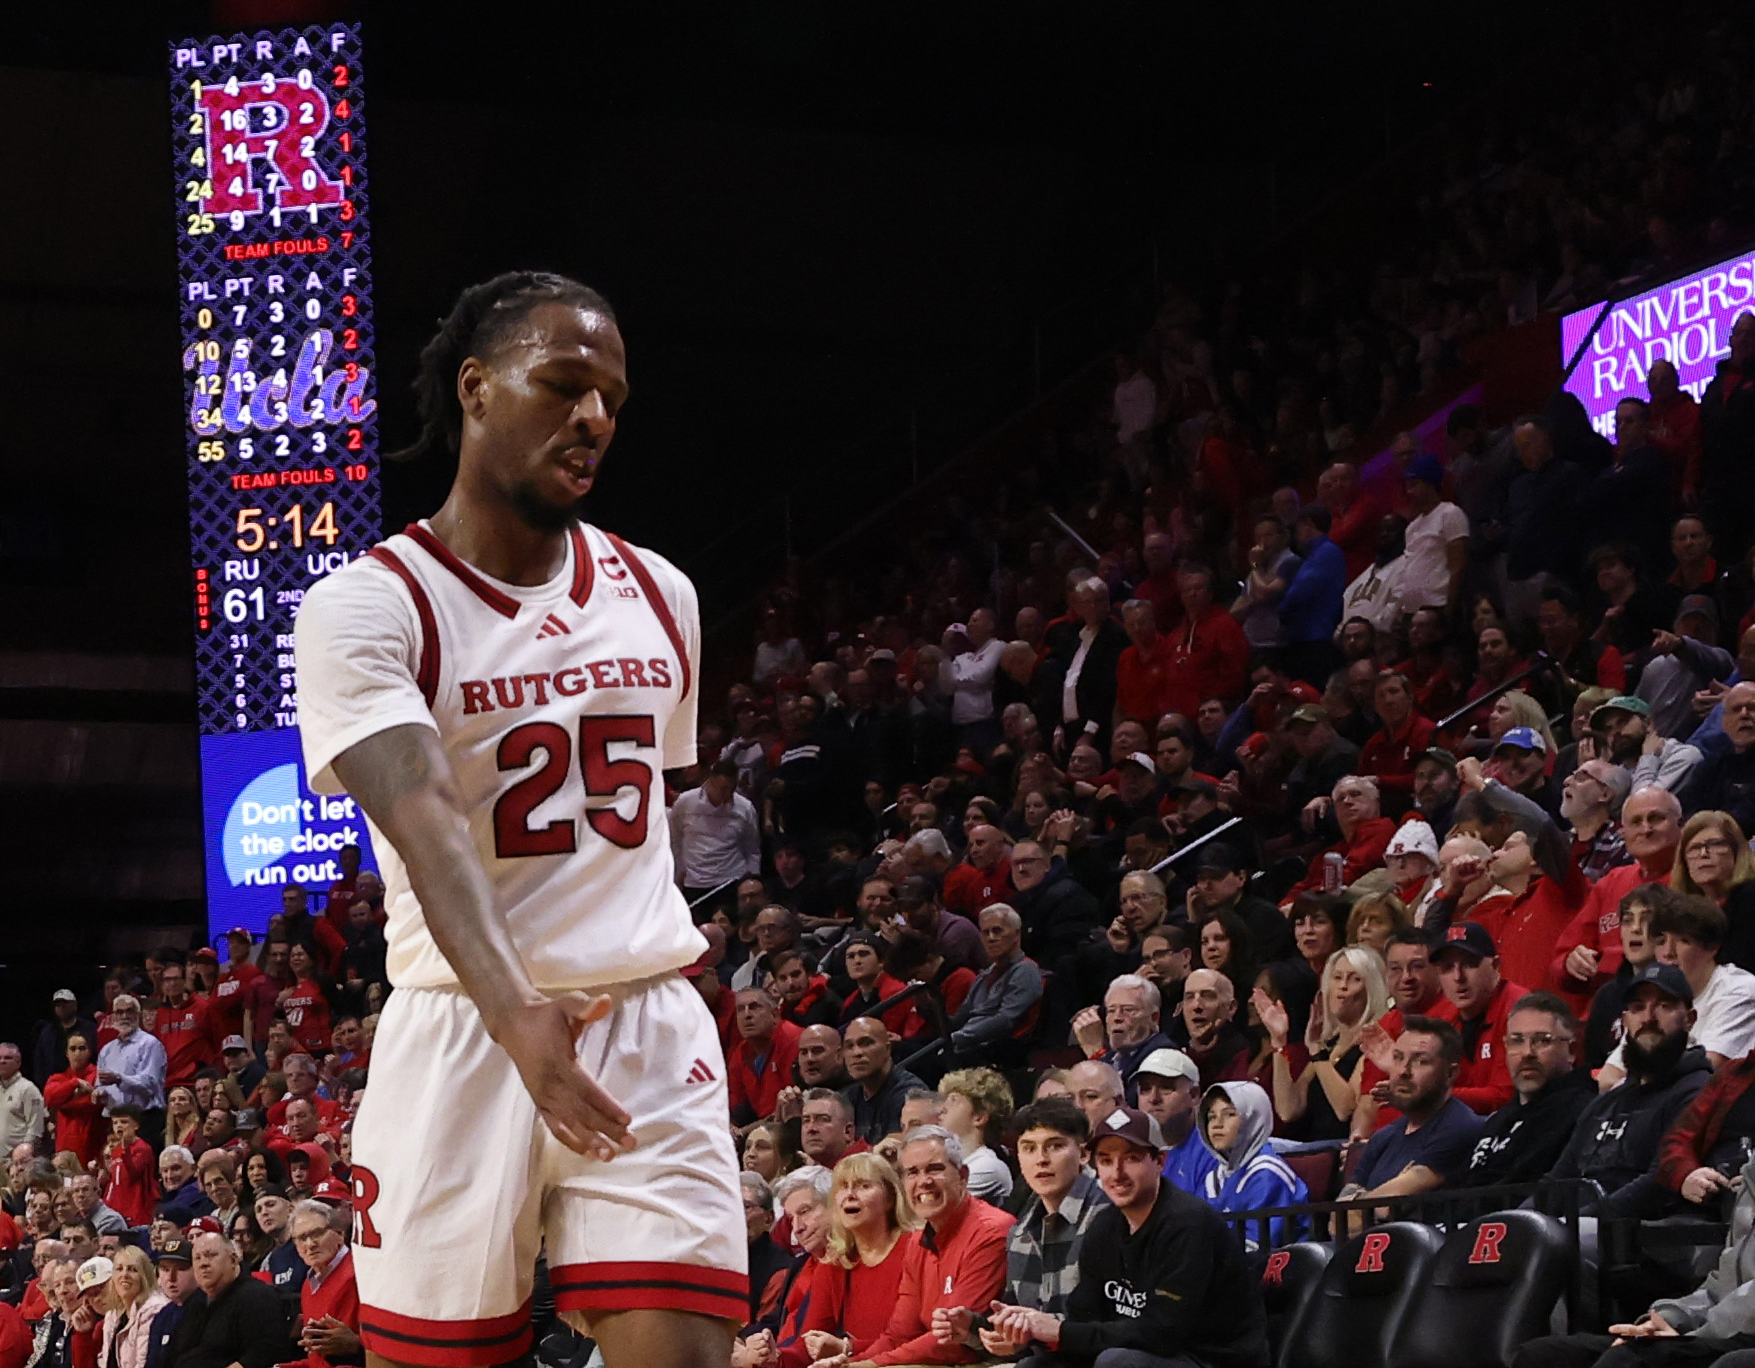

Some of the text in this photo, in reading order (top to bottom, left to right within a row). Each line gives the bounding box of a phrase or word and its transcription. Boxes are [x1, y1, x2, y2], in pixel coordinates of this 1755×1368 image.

[176, 33, 344, 68] PL PT R A F
[191, 66, 348, 100] 1 4 3 0 2
[190, 100, 349, 134] 2 16 3 2 4
[191, 134, 350, 166] 4 14 7 2 1
[187, 167, 352, 201] 24 4 7 0 1
[187, 201, 353, 234] 25 9 1 1 3
[224, 234, 353, 261] TEAM FOULS 7
[188, 268, 357, 302] PL PT R A F
[198, 296, 356, 328] 0 7 3 0 3
[196, 329, 357, 362] 10 5 2 1 2
[196, 362, 359, 395] 12 13 4 1 3
[198, 396, 362, 428] 34 4 3 2 1
[198, 430, 362, 462] 55 5 2 3 2
[231, 466, 366, 489] TEAM FOULS 10
[236, 502, 339, 552] 5:14
[225, 559, 260, 581] RU
[197, 569, 209, 629] BONUS
[223, 587, 265, 622] 61
[230, 633, 248, 648] 31
[234, 654, 244, 667] 7
[235, 674, 245, 688] 5
[460, 659, 671, 714] RUTGERS
[236, 695, 245, 708] 6
[236, 714, 246, 727] 9
[494, 715, 656, 858] 25
[242, 796, 355, 825] Don't let
[240, 826, 359, 855] the clock
[245, 859, 344, 886] run out.
[351, 1164, 382, 1250] R
[1355, 1233, 1390, 1273] R
[1468, 1223, 1507, 1264] R
[1261, 1252, 1290, 1287] R
